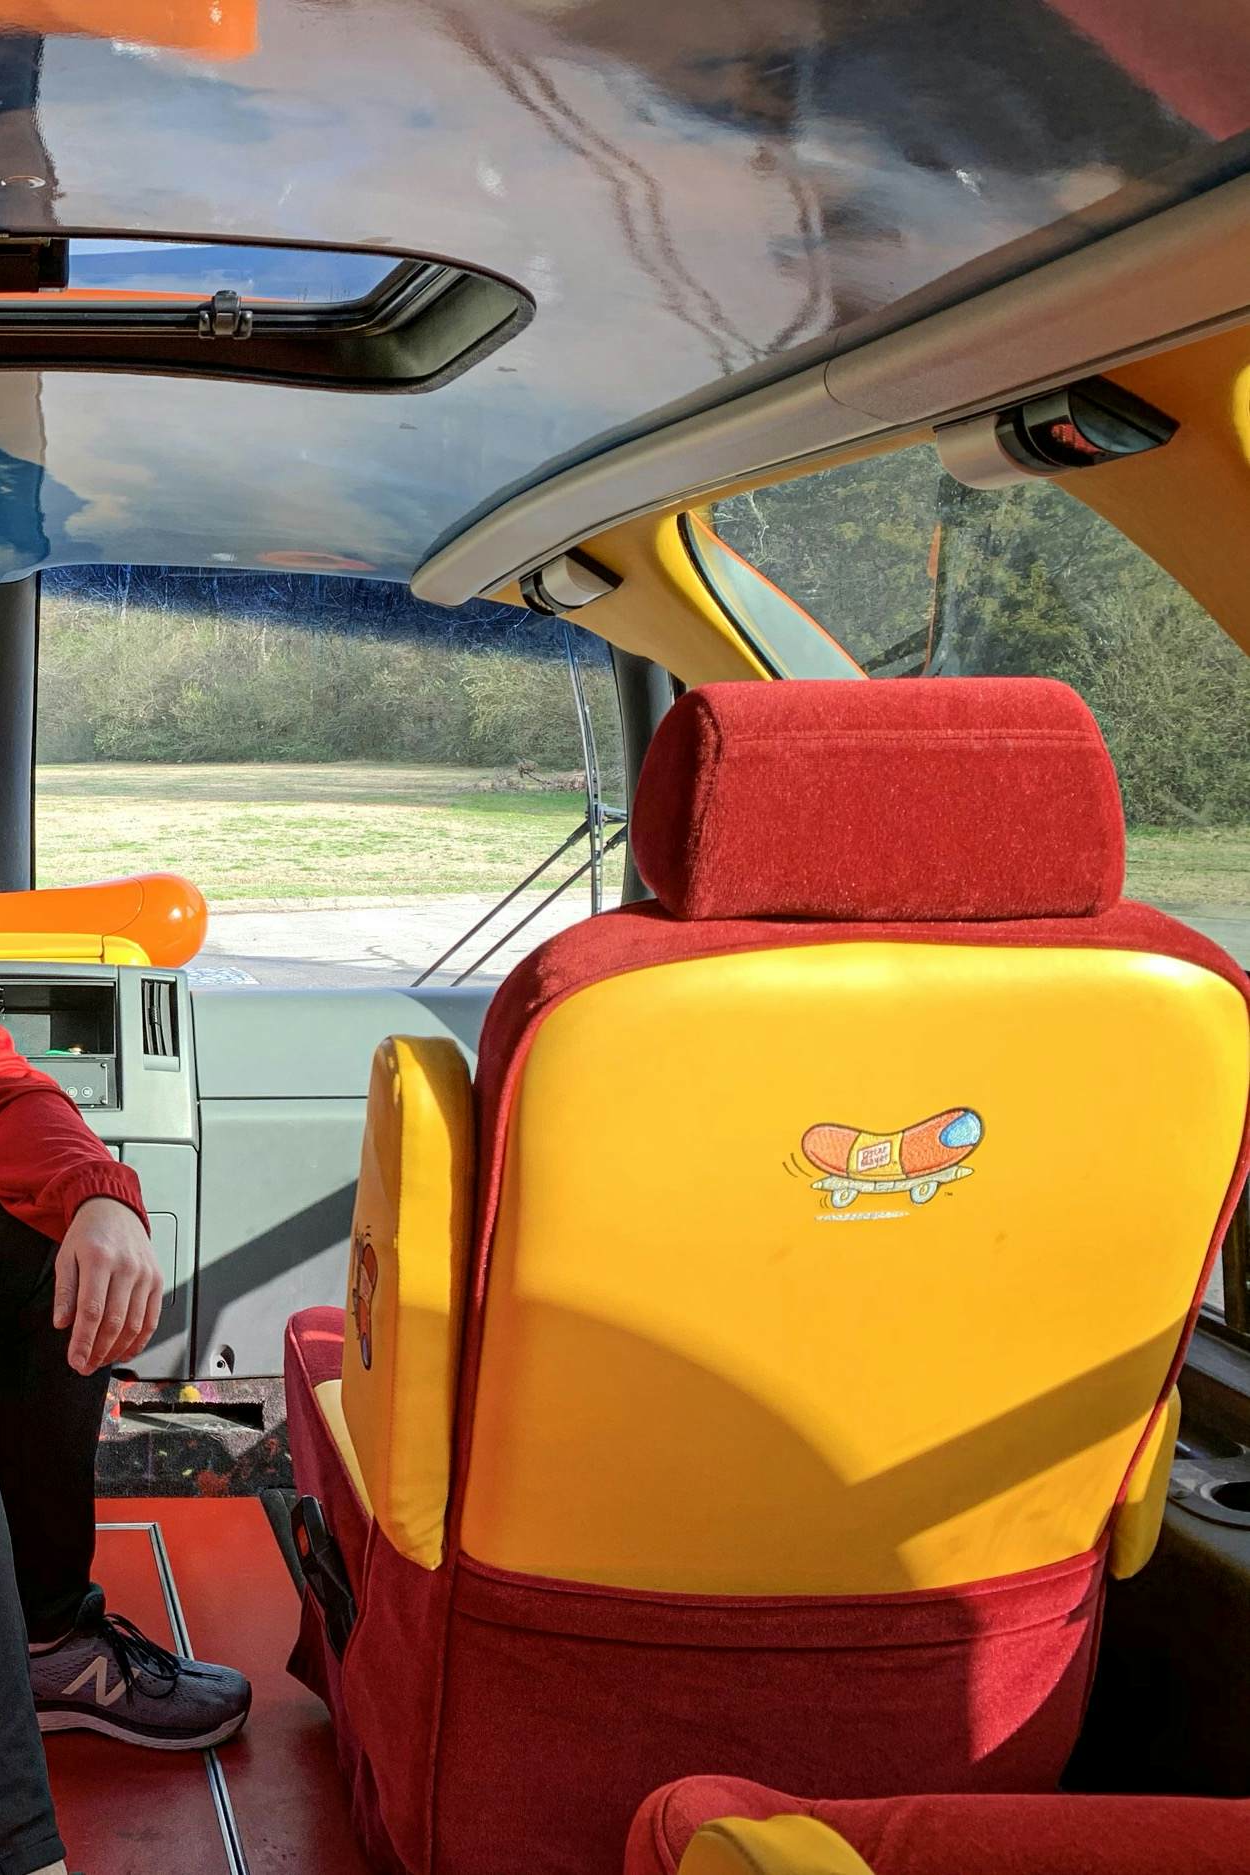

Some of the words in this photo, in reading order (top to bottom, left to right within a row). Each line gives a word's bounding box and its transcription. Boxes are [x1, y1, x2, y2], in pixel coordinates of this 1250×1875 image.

[862, 1146, 888, 1158] Oscar
[860, 1154, 889, 1168] Mayer
[61, 1655, 142, 1707] N
